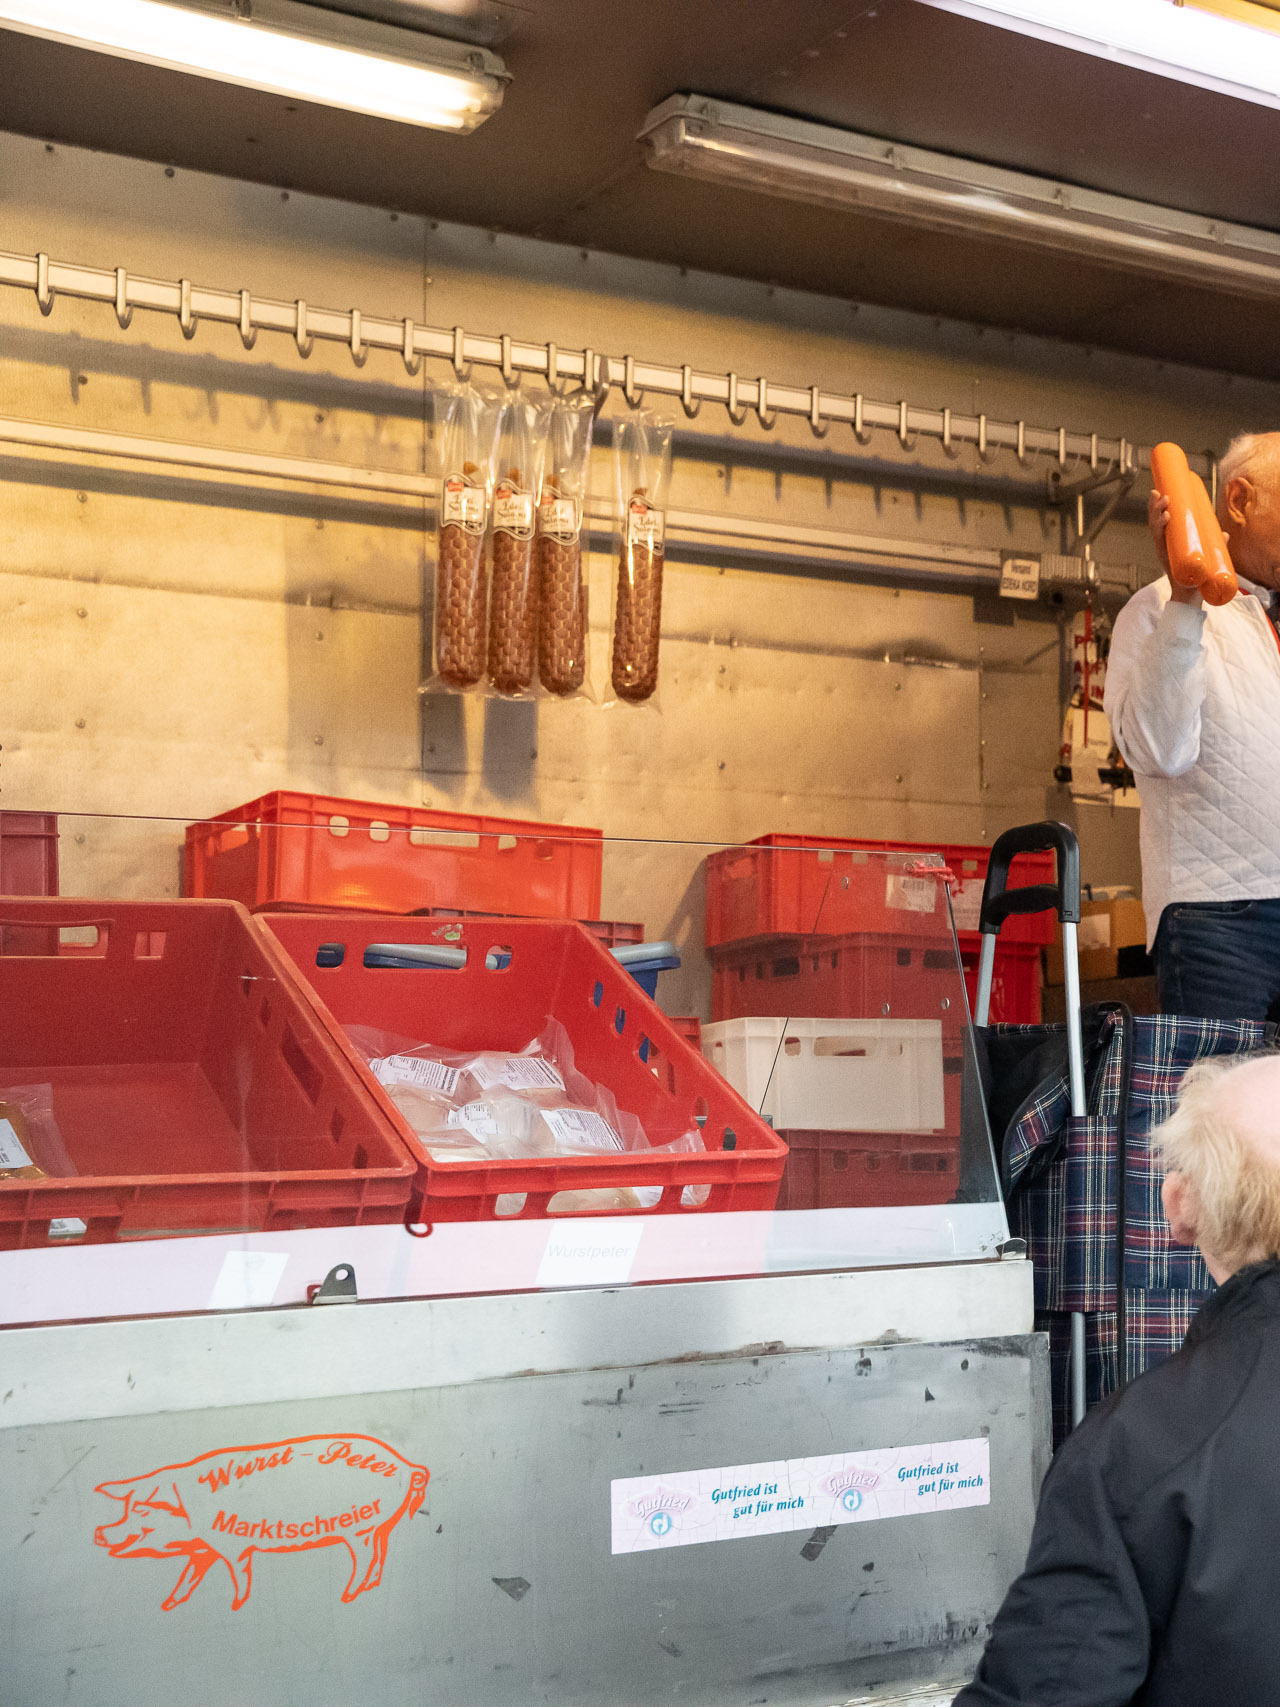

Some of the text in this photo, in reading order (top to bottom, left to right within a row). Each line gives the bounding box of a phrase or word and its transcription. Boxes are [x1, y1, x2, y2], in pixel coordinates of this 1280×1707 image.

[198, 1446, 294, 1494] Wurst
[317, 1441, 399, 1478] Peter
[898, 1462, 960, 1482] Gutfried ist
[711, 1483, 778, 1504] Gutfried ist
[827, 1471, 880, 1496] Gutfried
[918, 1475, 984, 1496] gut für mich
[211, 1498, 382, 1540] Marktschreier
[732, 1496, 805, 1519] gut für mich
